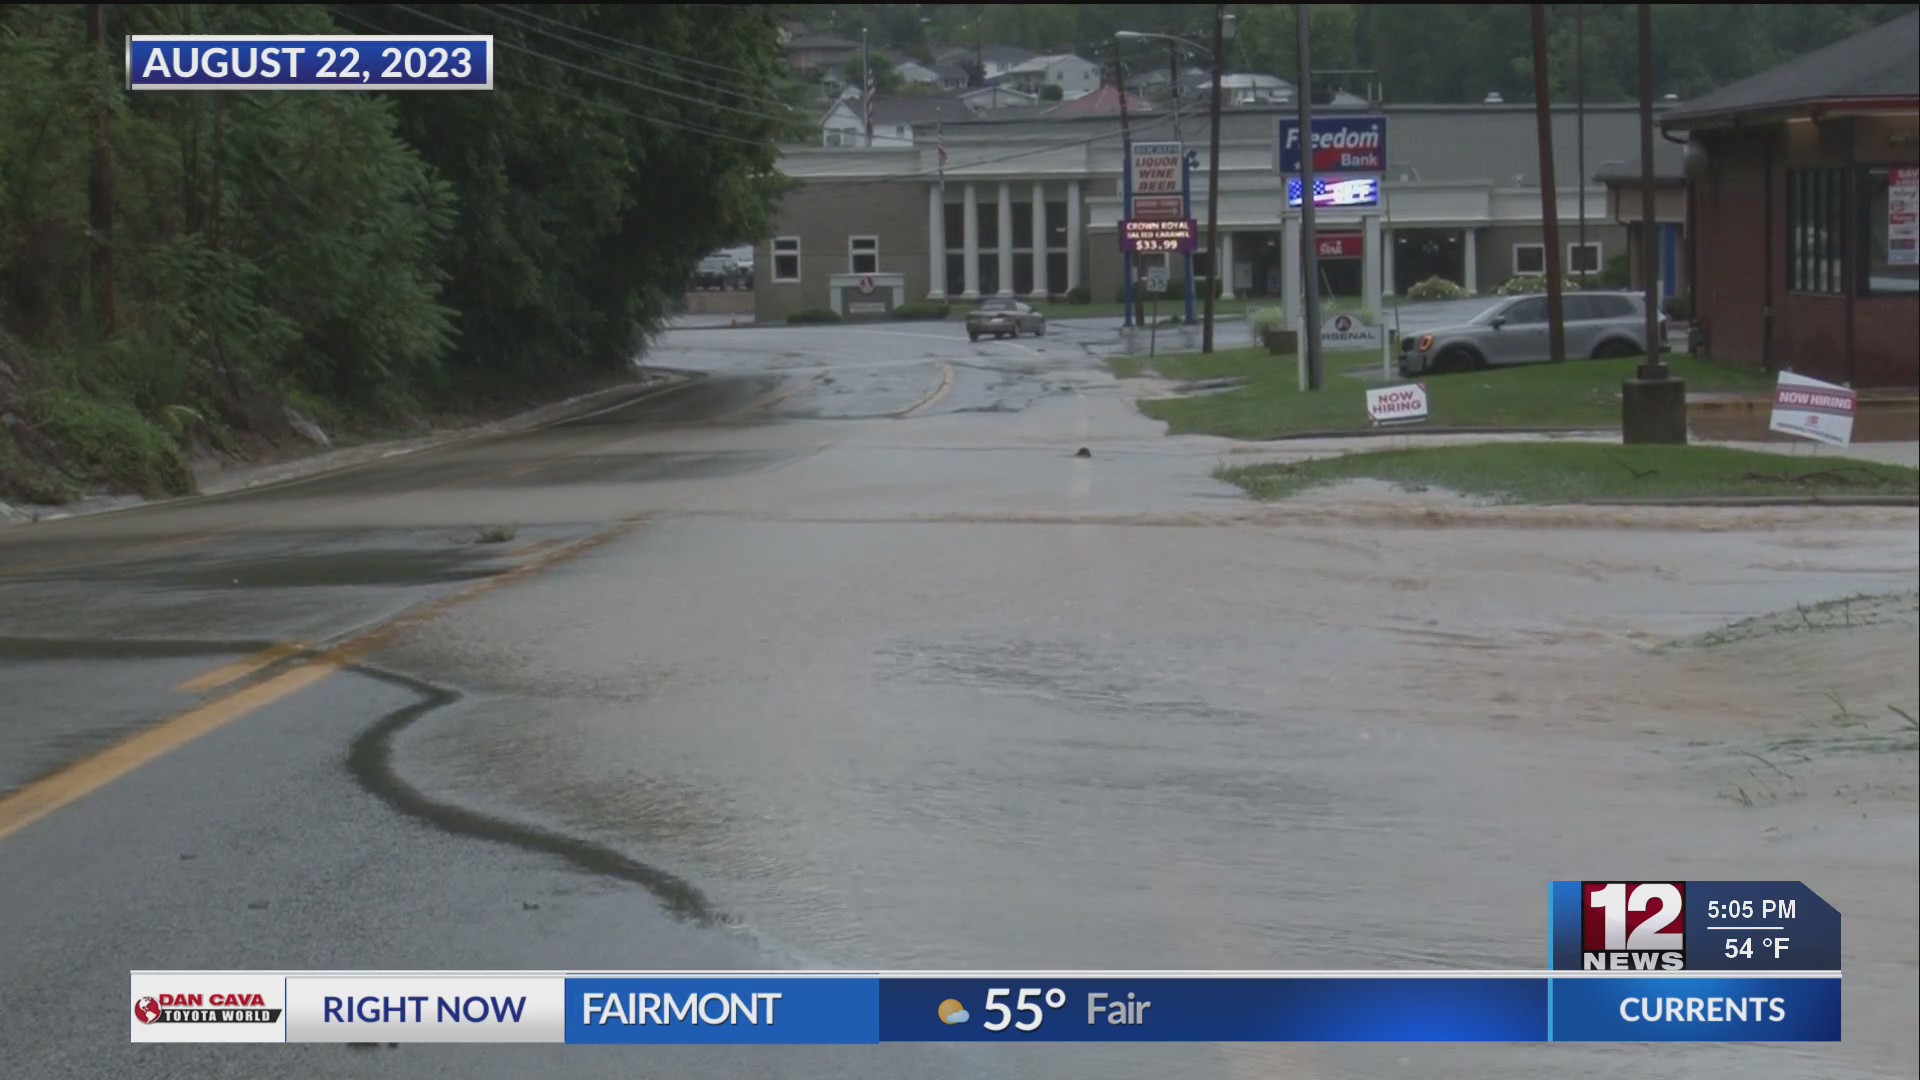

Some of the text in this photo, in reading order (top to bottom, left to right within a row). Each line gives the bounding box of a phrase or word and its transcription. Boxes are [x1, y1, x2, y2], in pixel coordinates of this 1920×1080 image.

[1286, 124, 1378, 149] Feedom
[1136, 157, 1178, 167] LIQUOR
[1341, 153, 1378, 166] Bank
[1139, 168, 1175, 178] WINE
[1126, 222, 1189, 230] CROWN ROYAL
[1136, 240, 1178, 250] $33.99
[1322, 332, 1376, 340] RSENAL
[1378, 391, 1414, 403] NOW
[1779, 391, 1852, 410] NOW HIRING
[1372, 400, 1422, 413] HIRING
